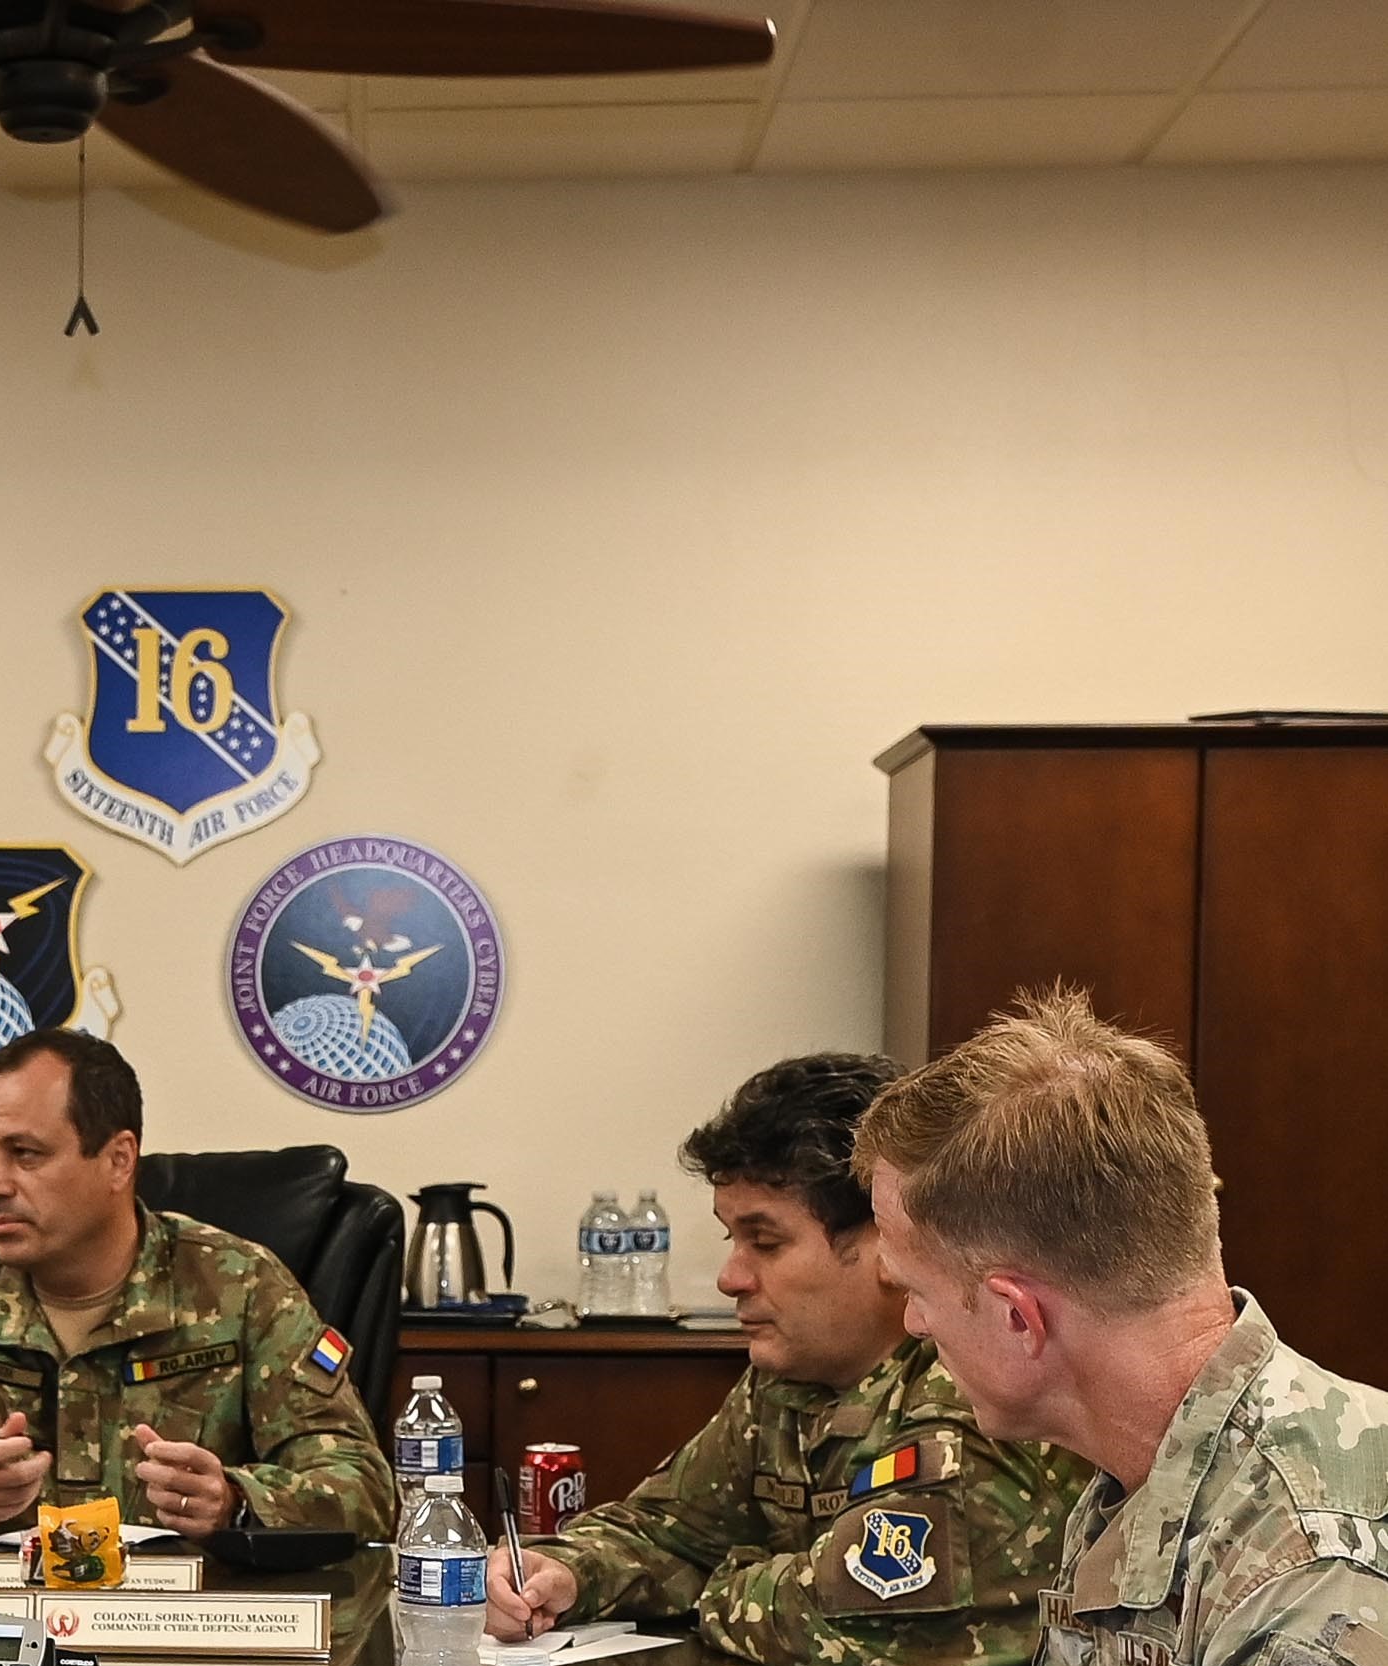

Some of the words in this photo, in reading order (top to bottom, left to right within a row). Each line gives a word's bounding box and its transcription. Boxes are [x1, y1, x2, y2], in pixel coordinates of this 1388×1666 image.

[126, 627, 233, 734] 16
[64, 767, 174, 846] SIXTEENTH
[190, 809, 226, 848] AIR
[234, 770, 298, 824] FORCE
[246, 866, 305, 933] FORCE
[310, 843, 487, 929] HEADQUARTERS
[238, 941, 258, 1013] JOINT
[476, 938, 497, 1018] CYBER
[303, 1075, 341, 1100] AIR
[350, 1078, 424, 1104] FORCE
[873, 1522, 911, 1559] 16
[91, 1623, 160, 1632] COMMANDER
[163, 1624, 199, 1633] CYBER
[202, 1624, 251, 1633] DEFENSE
[254, 1624, 298, 1633] AGENCY
[93, 1612, 152, 1622] COLONEL
[155, 1613, 244, 1623] SORIN-TEOFIL
[246, 1614, 299, 1624] MANOLE
